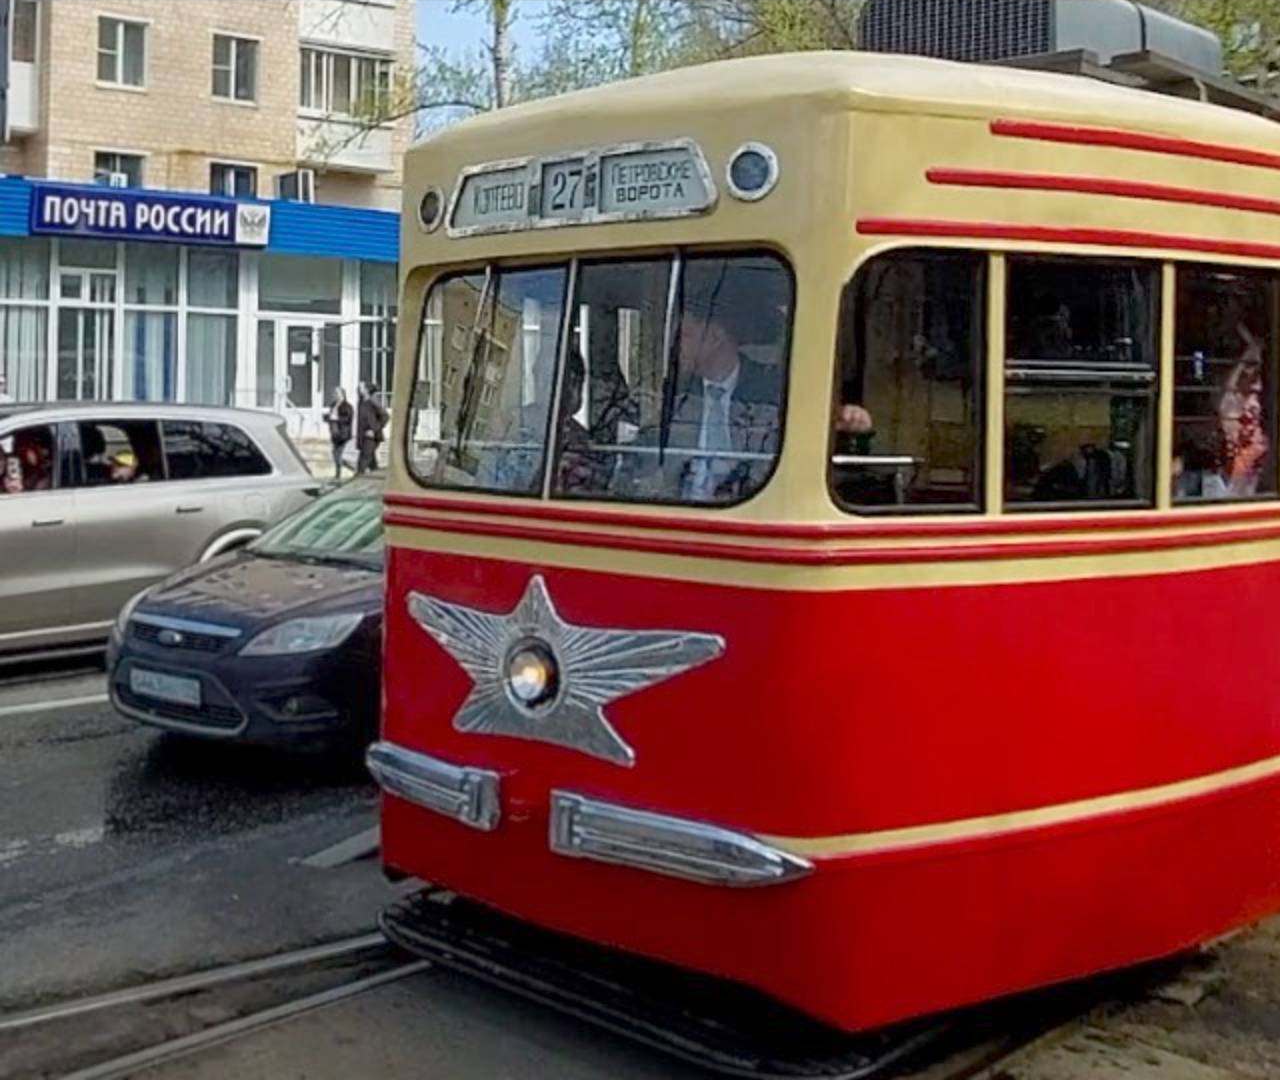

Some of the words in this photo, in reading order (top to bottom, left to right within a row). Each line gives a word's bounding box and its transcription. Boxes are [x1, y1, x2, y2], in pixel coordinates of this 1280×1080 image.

[551, 169, 583, 211] 27
[616, 182, 686, 203] ВОРОТА
[43, 195, 127, 228] ПОЧТА
[135, 203, 230, 236] РОССИИ
